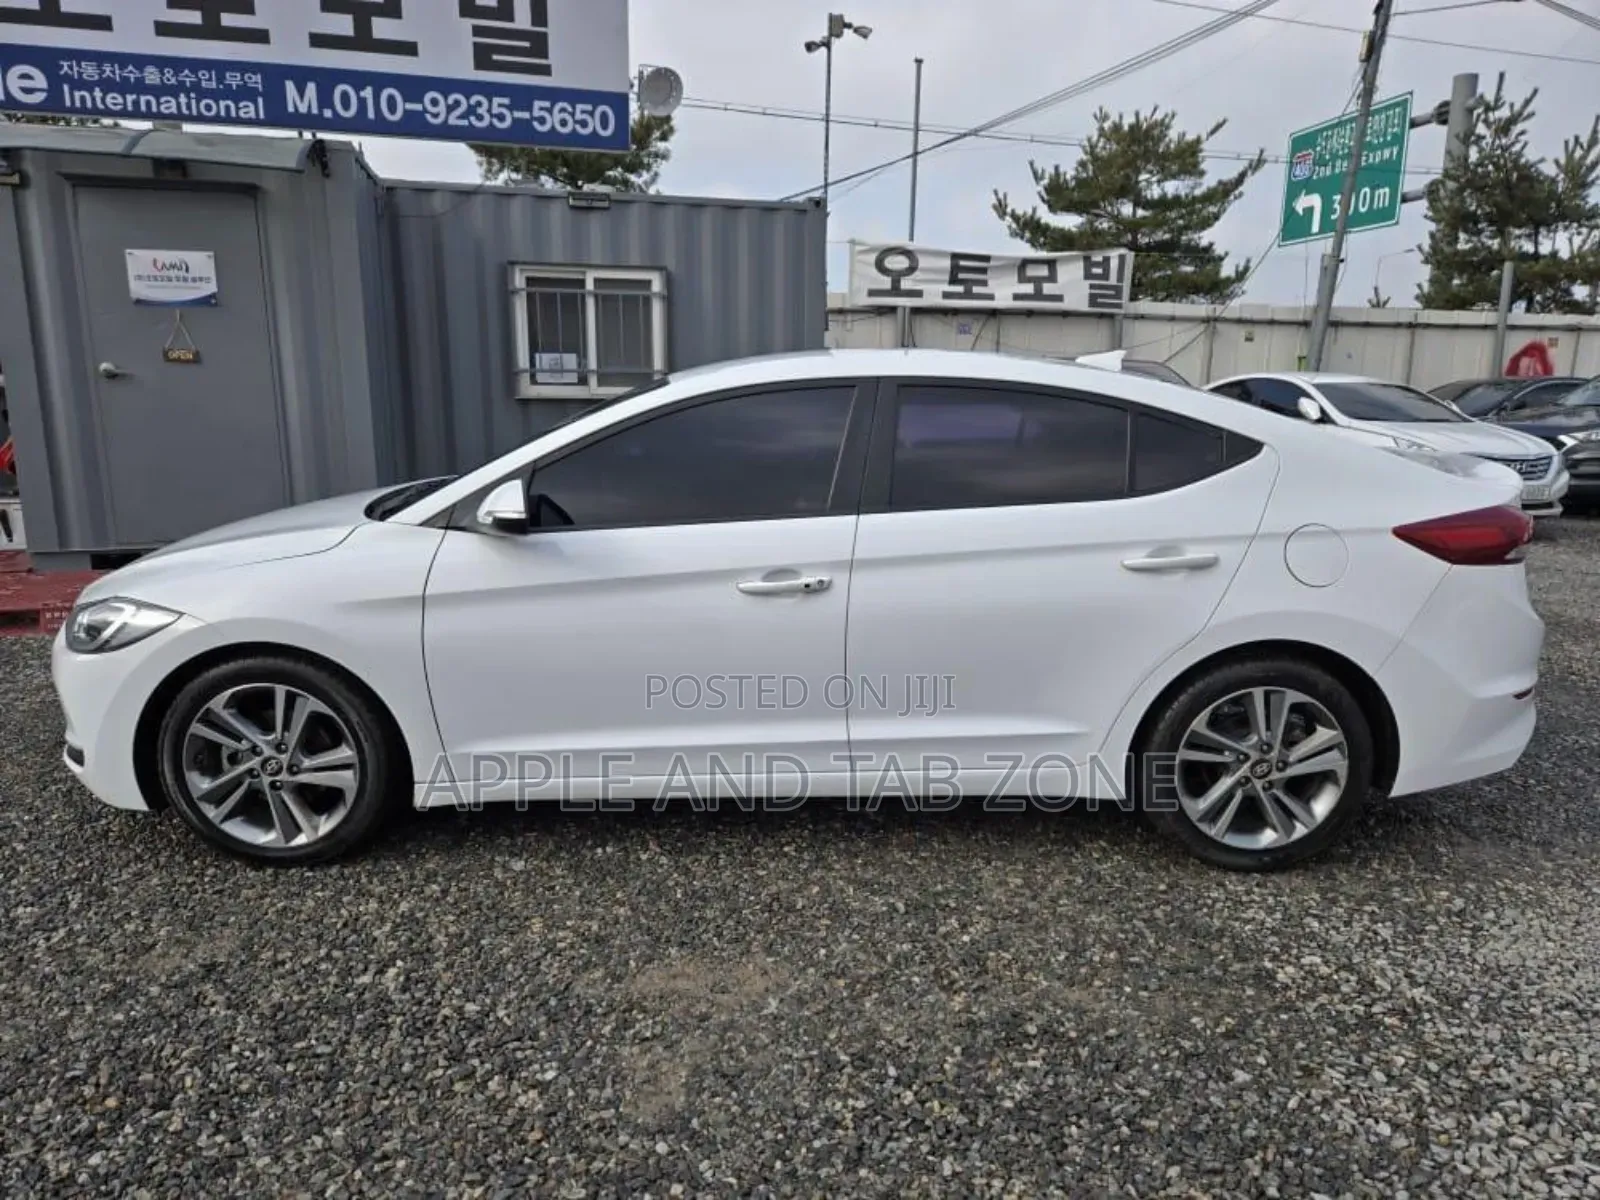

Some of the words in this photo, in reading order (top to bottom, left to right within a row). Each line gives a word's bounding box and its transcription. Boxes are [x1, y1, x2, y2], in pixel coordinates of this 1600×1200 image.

[0, 62, 48, 104] e
[62, 83, 265, 120] International
[284, 79, 616, 137] M.010-9235-5650
[867, 246, 1128, 309] 오토모빌
